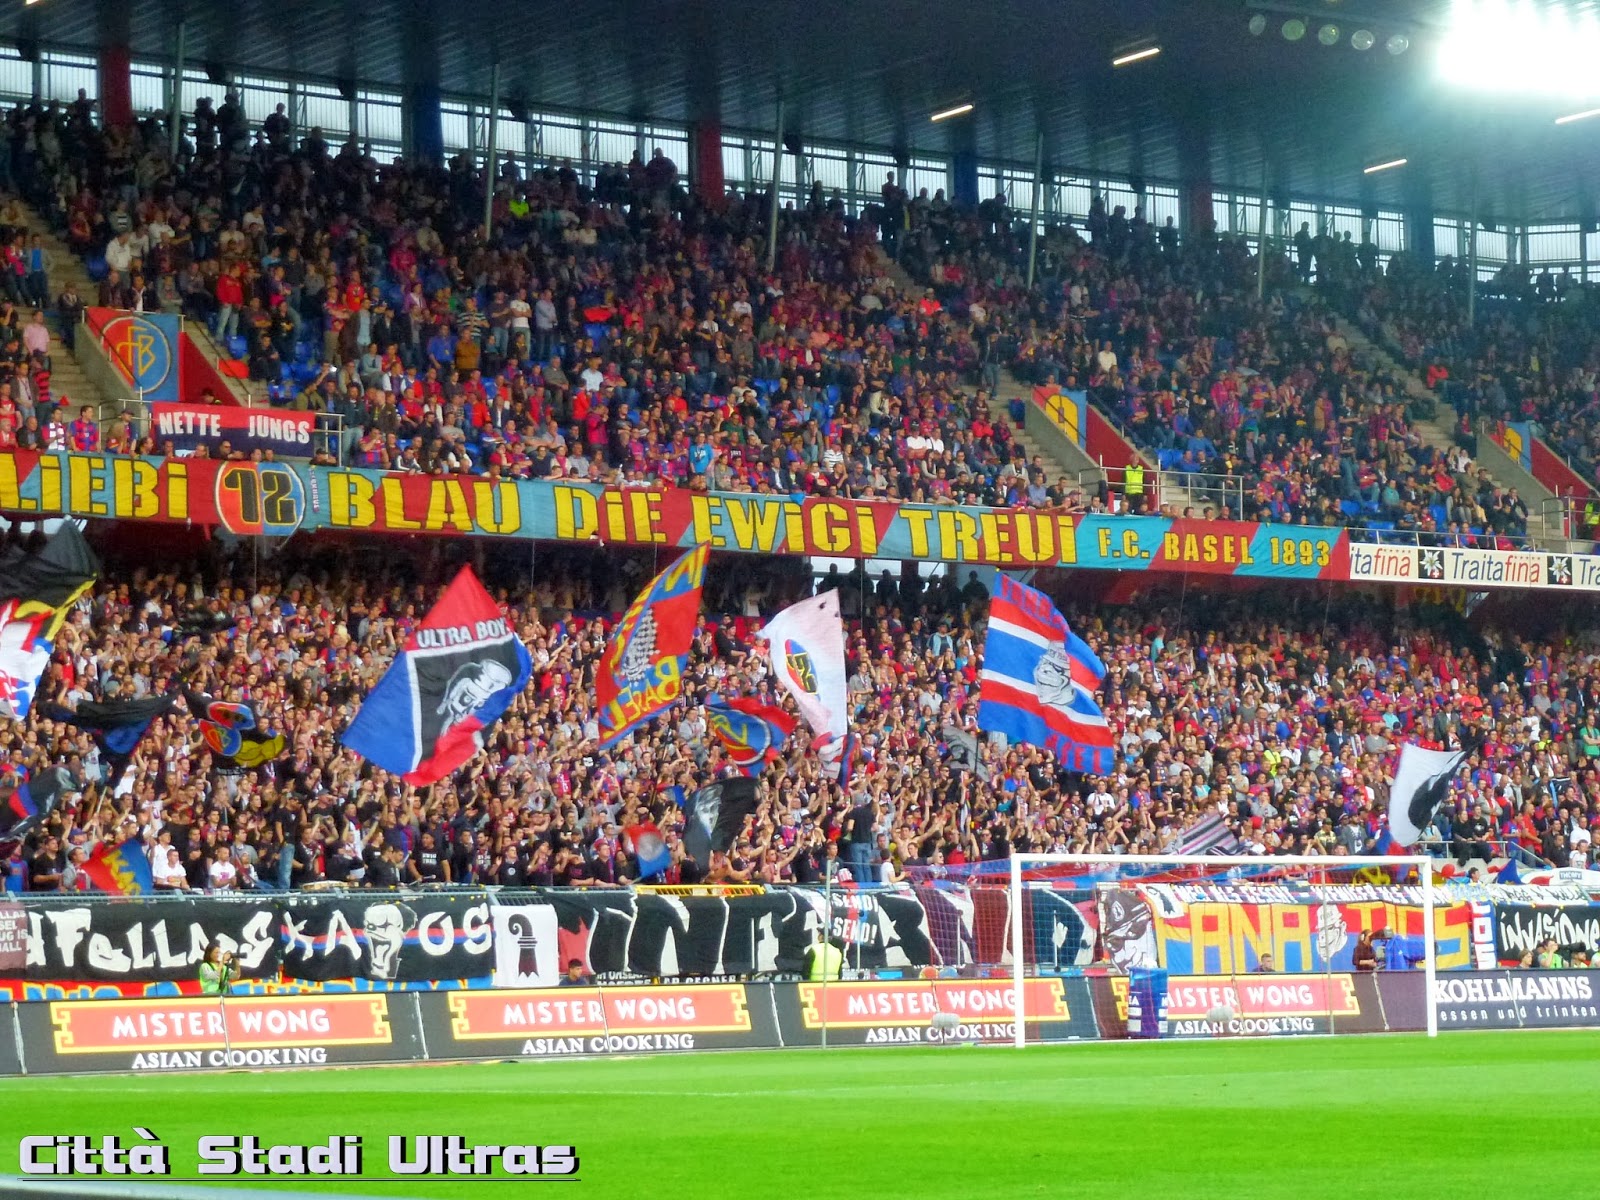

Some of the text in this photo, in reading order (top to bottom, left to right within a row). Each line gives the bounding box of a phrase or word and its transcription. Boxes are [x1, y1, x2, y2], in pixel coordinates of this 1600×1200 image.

[159, 411, 311, 444] NETTE JUNGS
[224, 467, 297, 526] 12
[328, 471, 522, 535] BLAU
[1098, 527, 1149, 559] F.C.
[1164, 531, 1254, 565] BASEL
[1269, 536, 1331, 567] 1893
[1452, 551, 1541, 583] Traitafina
[416, 616, 508, 648] ULTRA BOY
[283, 902, 493, 961] KAOS
[833, 916, 878, 944] SEND!
[847, 987, 1016, 1015] MISTER WONG
[1249, 985, 1314, 1006] WONG
[1434, 976, 1593, 1003] KOHLMANNS
[112, 1008, 331, 1038] MISTER WONG
[503, 997, 696, 1026] MISTER WONG
[1440, 1004, 1597, 1021] essen und trinken
[865, 1023, 1017, 1043] ASIAN COOKING
[1174, 1017, 1315, 1035] ASIAN COOKING
[132, 1047, 328, 1070] ASIAN COOKING
[522, 1033, 695, 1056] ASIAN COOKING
